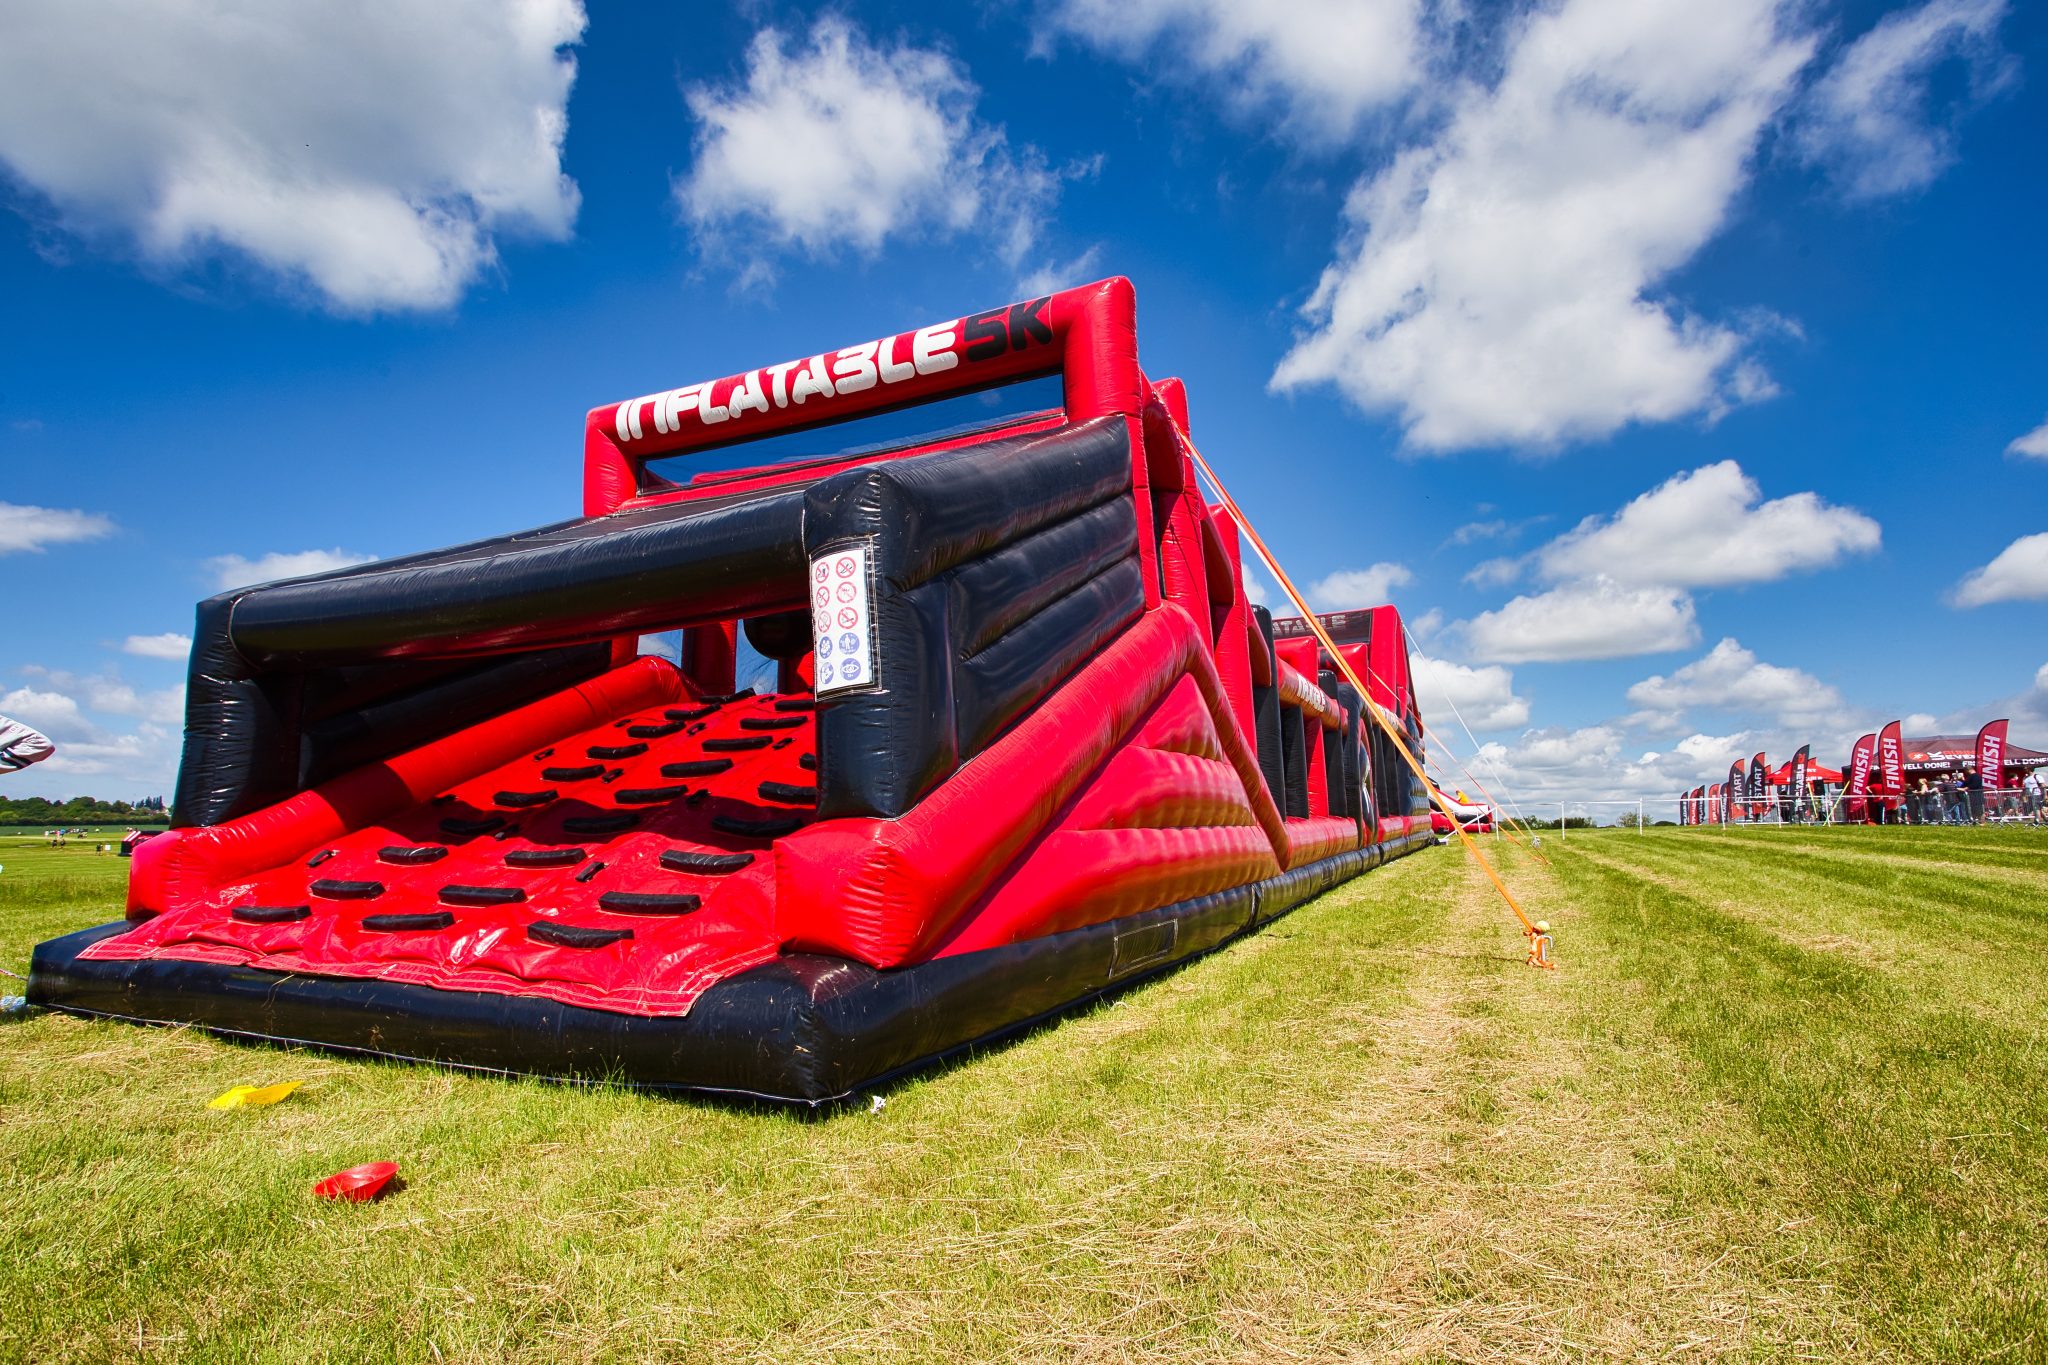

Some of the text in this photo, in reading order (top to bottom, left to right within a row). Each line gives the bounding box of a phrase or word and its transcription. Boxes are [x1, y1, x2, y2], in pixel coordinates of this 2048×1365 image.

[1755, 767, 1763, 799] START
[1853, 748, 1869, 794] FINISH
[1883, 738, 1900, 789] FINISH
[1982, 735, 2000, 790] FINISH
[1734, 774, 1743, 803] START
